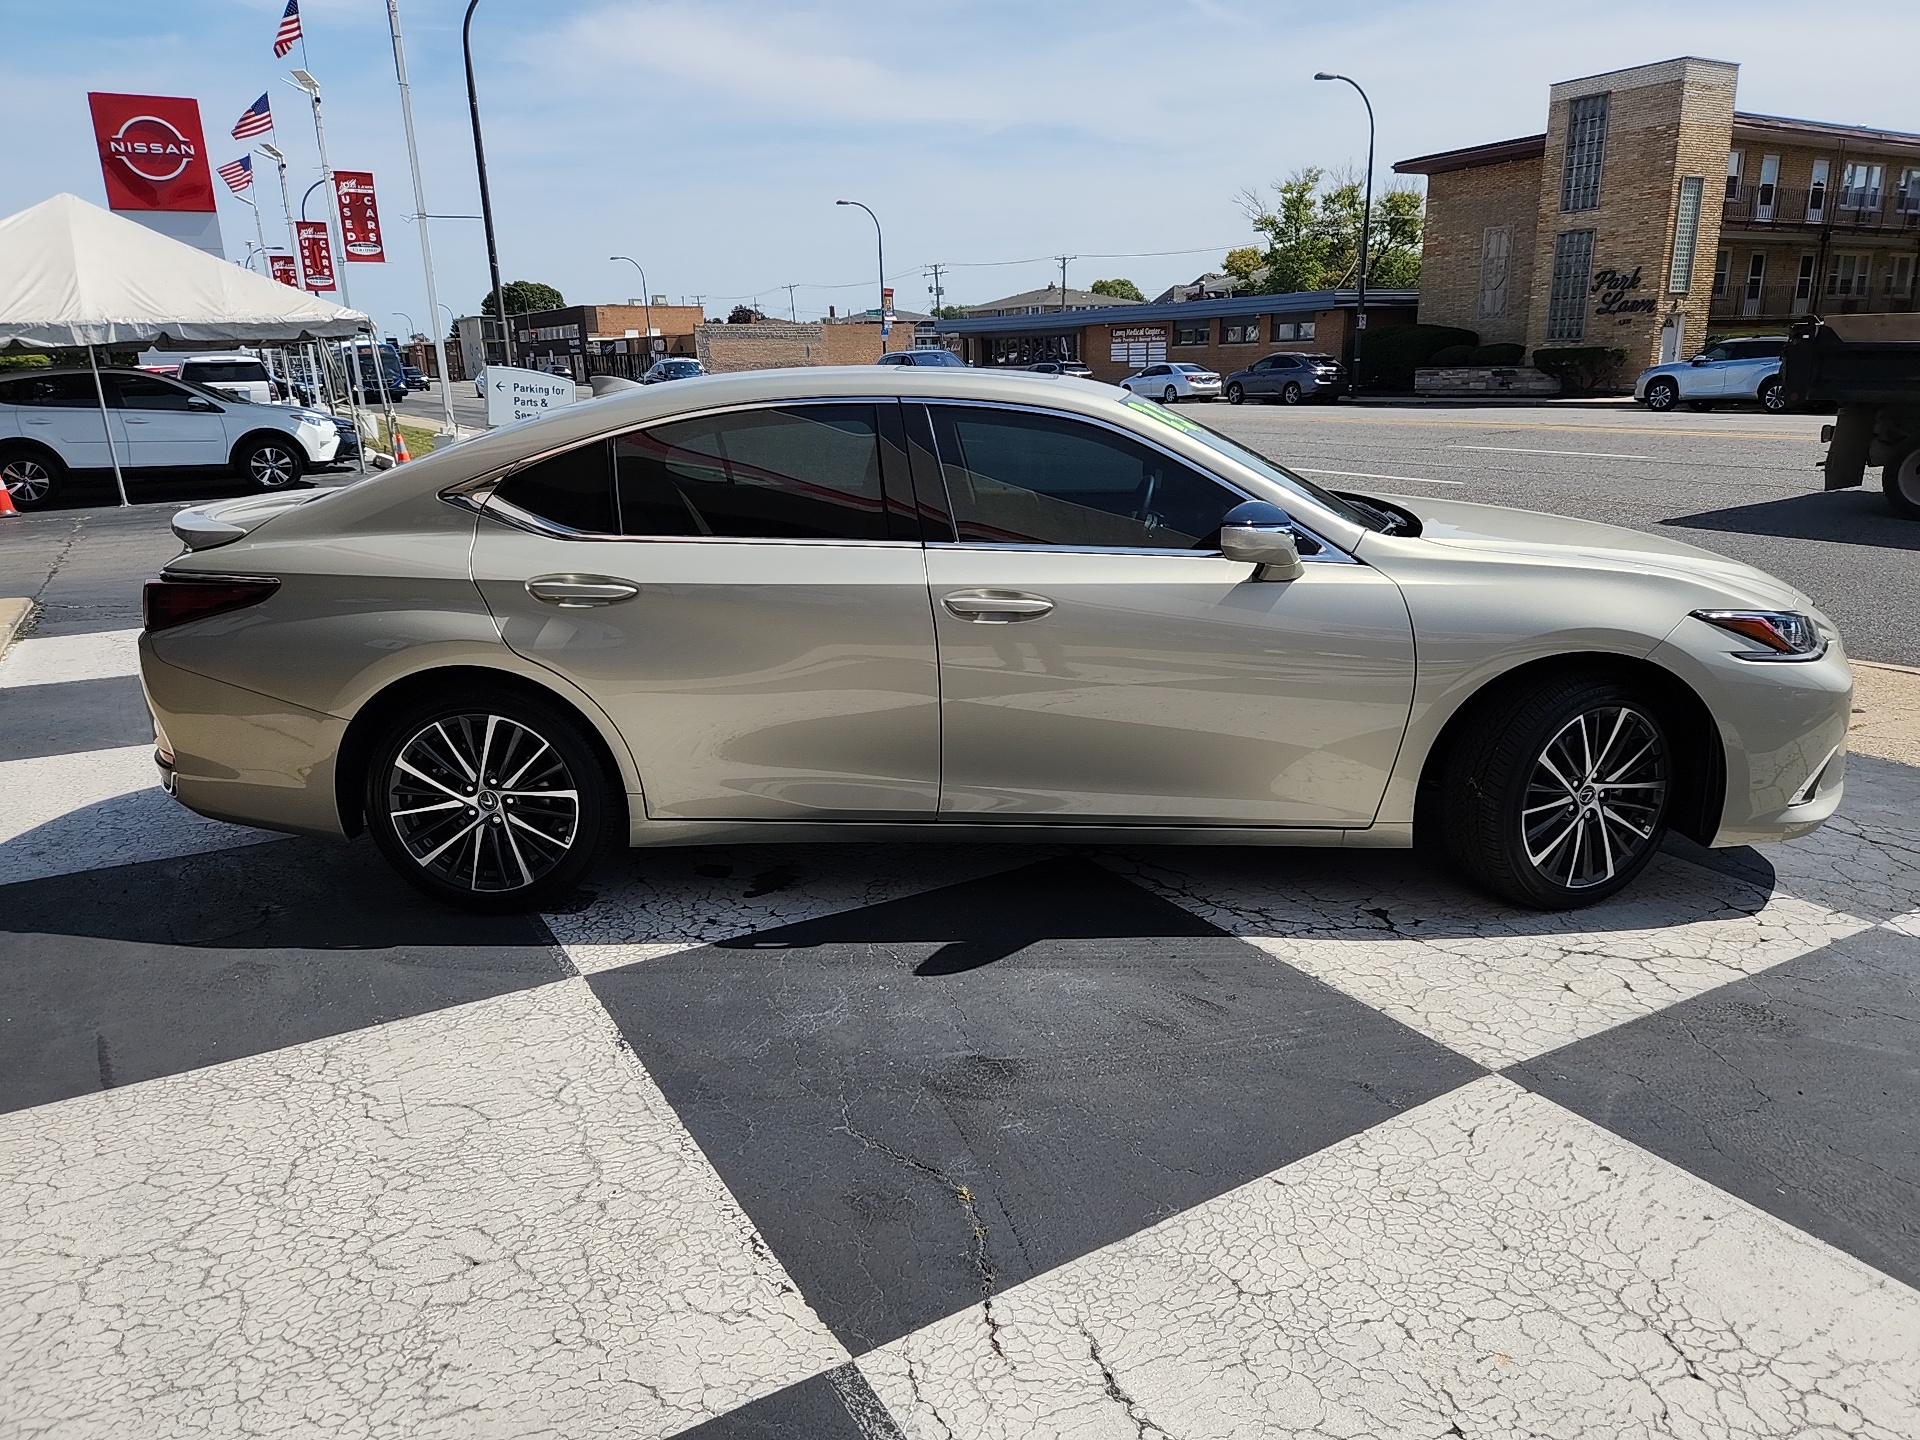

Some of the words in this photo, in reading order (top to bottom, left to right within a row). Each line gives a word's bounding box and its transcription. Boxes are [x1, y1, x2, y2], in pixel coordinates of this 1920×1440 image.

[109, 141, 195, 155] NISSAN
[341, 195, 357, 241] USED
[363, 196, 377, 242] CARS
[301, 239, 314, 275] USED
[319, 240, 331, 276] CARS
[1590, 265, 1643, 293] Park
[1595, 290, 1657, 315] Lawn
[513, 382, 550, 396] Parking
[552, 386, 566, 395] for
[513, 397, 539, 407] Parts
[540, 398, 549, 408] &
